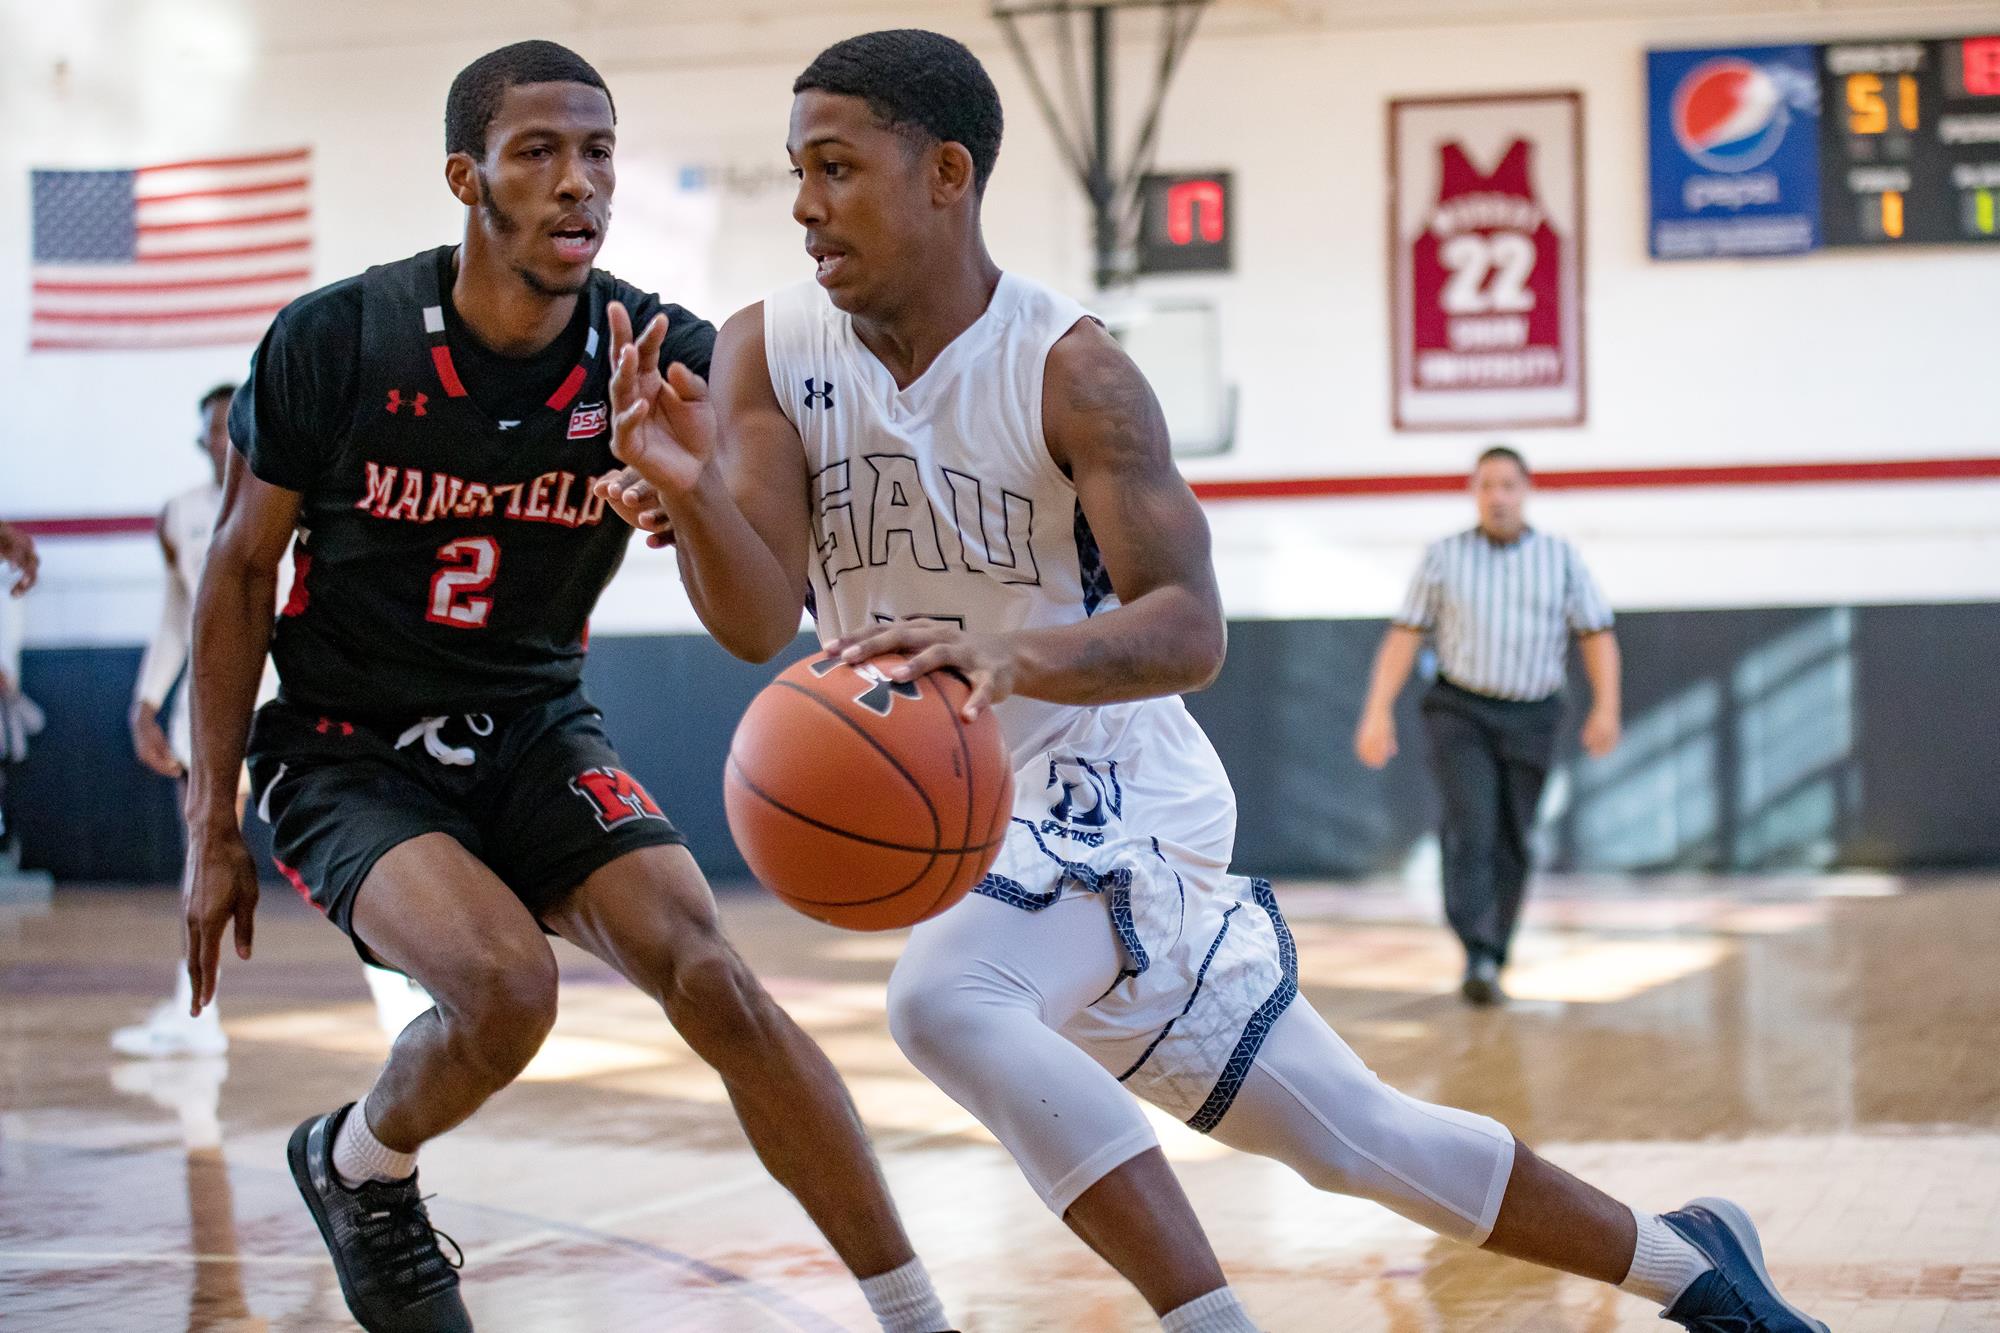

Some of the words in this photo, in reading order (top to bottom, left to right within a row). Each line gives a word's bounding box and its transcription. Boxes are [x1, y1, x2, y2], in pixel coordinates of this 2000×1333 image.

[1846, 72, 1919, 133] 51
[1441, 234, 1536, 311] 22
[813, 454, 1040, 590] SAU
[425, 534, 500, 630] 2
[568, 766, 670, 832] M
